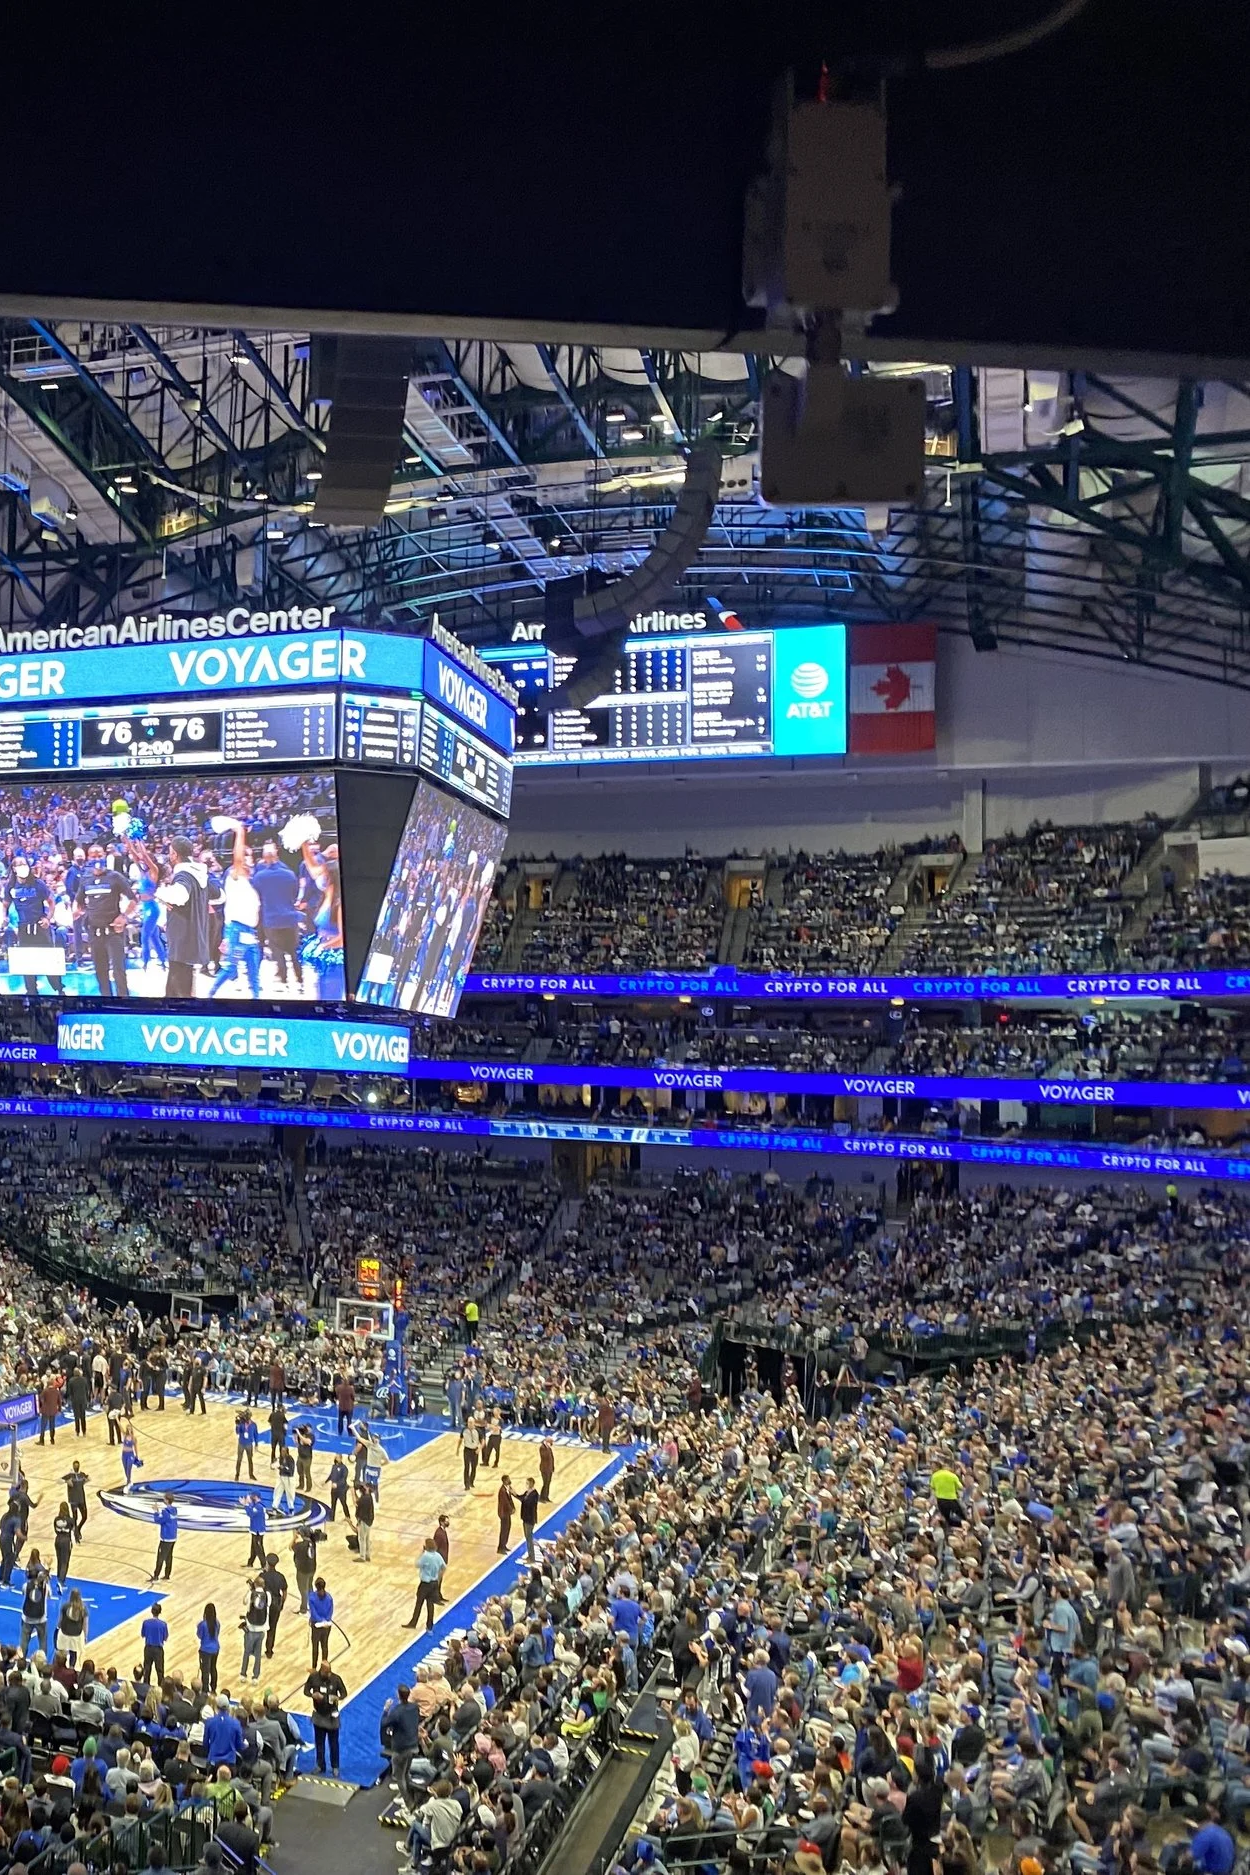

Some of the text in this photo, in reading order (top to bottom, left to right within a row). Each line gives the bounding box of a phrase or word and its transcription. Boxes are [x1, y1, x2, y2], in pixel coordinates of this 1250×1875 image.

[169, 640, 367, 686] VOYAGER
[438, 661, 488, 729] VOYAGER
[786, 701, 835, 718] AT&T
[97, 721, 133, 744] 76
[170, 717, 205, 741] 76
[128, 740, 174, 756] 12:00
[303, 747, 310, 755] 2
[402, 740, 414, 750] 12
[482, 978, 595, 989] CRYPTO FOR ALL
[619, 980, 739, 991] CRYPTO FOR ALL
[764, 982, 887, 992] CRYPTO FOR ALL
[913, 981, 1040, 992] CRYPTO FOR ALL
[1067, 978, 1201, 991] CRYPTO FOR ALL
[141, 1024, 288, 1057] VOYAGER
[332, 1031, 409, 1063] VOYAGE
[470, 1066, 533, 1079] VOYAGER
[654, 1073, 722, 1086] VOYAGER
[844, 1079, 914, 1093] VOYAGER
[1039, 1085, 1114, 1100] VOYAGER
[14, 1101, 32, 1111] ALL
[152, 1106, 241, 1120] CRYPTO FOR ALL
[370, 1116, 462, 1130] CRYPTO FOR ALL
[844, 1140, 951, 1155] CRYPTO FOR ALL
[1102, 1155, 1206, 1172] CRYPTO FOR ALL
[3, 1400, 33, 1419] VOYAGER
